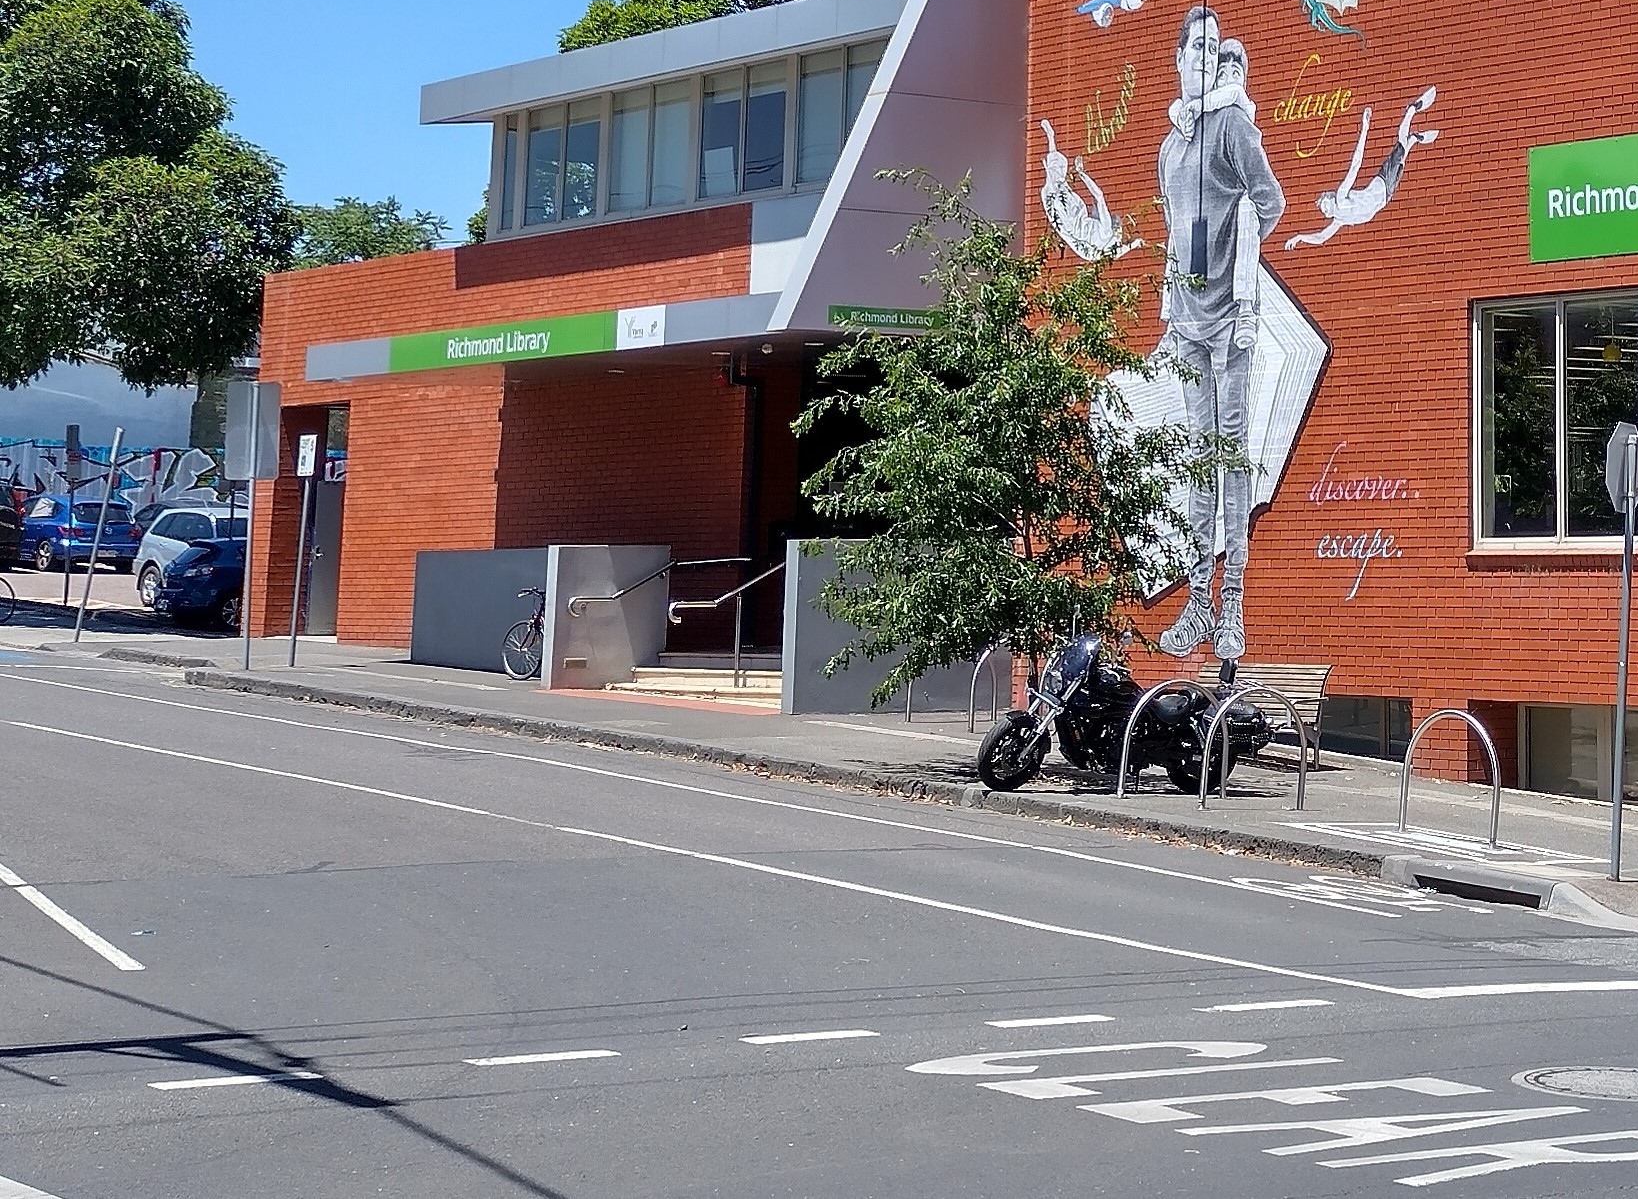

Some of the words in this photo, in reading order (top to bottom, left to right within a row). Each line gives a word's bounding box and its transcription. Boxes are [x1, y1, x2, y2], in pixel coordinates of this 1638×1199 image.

[1273, 53, 1355, 158] change
[850, 311, 898, 323] Richmond
[900, 313, 935, 327] Library
[447, 332, 504, 359] Richmond
[506, 331, 550, 353] Library
